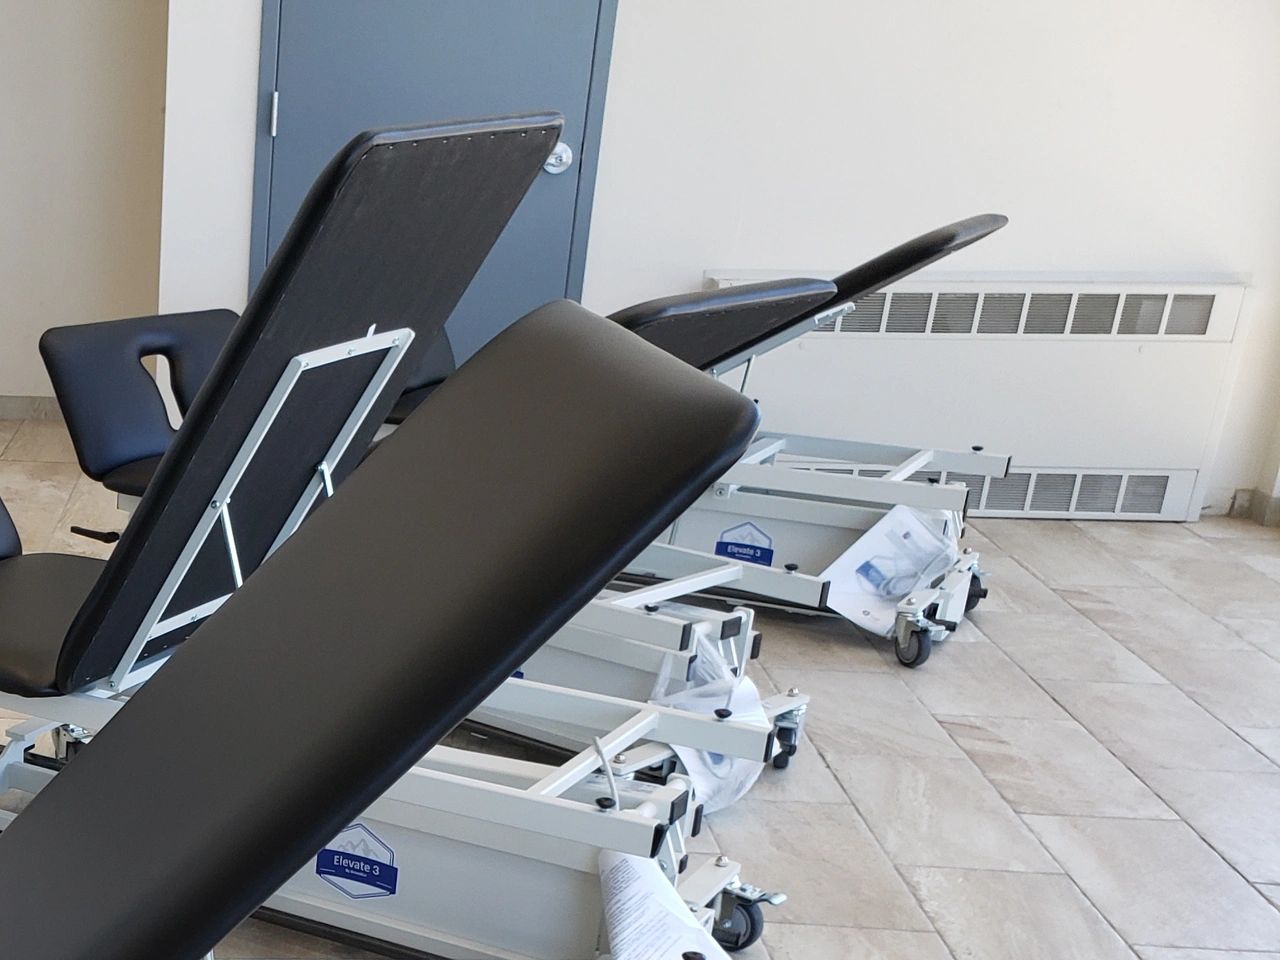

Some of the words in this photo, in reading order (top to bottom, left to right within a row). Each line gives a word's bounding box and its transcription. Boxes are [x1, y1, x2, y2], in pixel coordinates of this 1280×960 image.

[755, 549, 761, 557] 3
[333, 855, 371, 873] Elevate
[372, 865, 380, 876] 3
